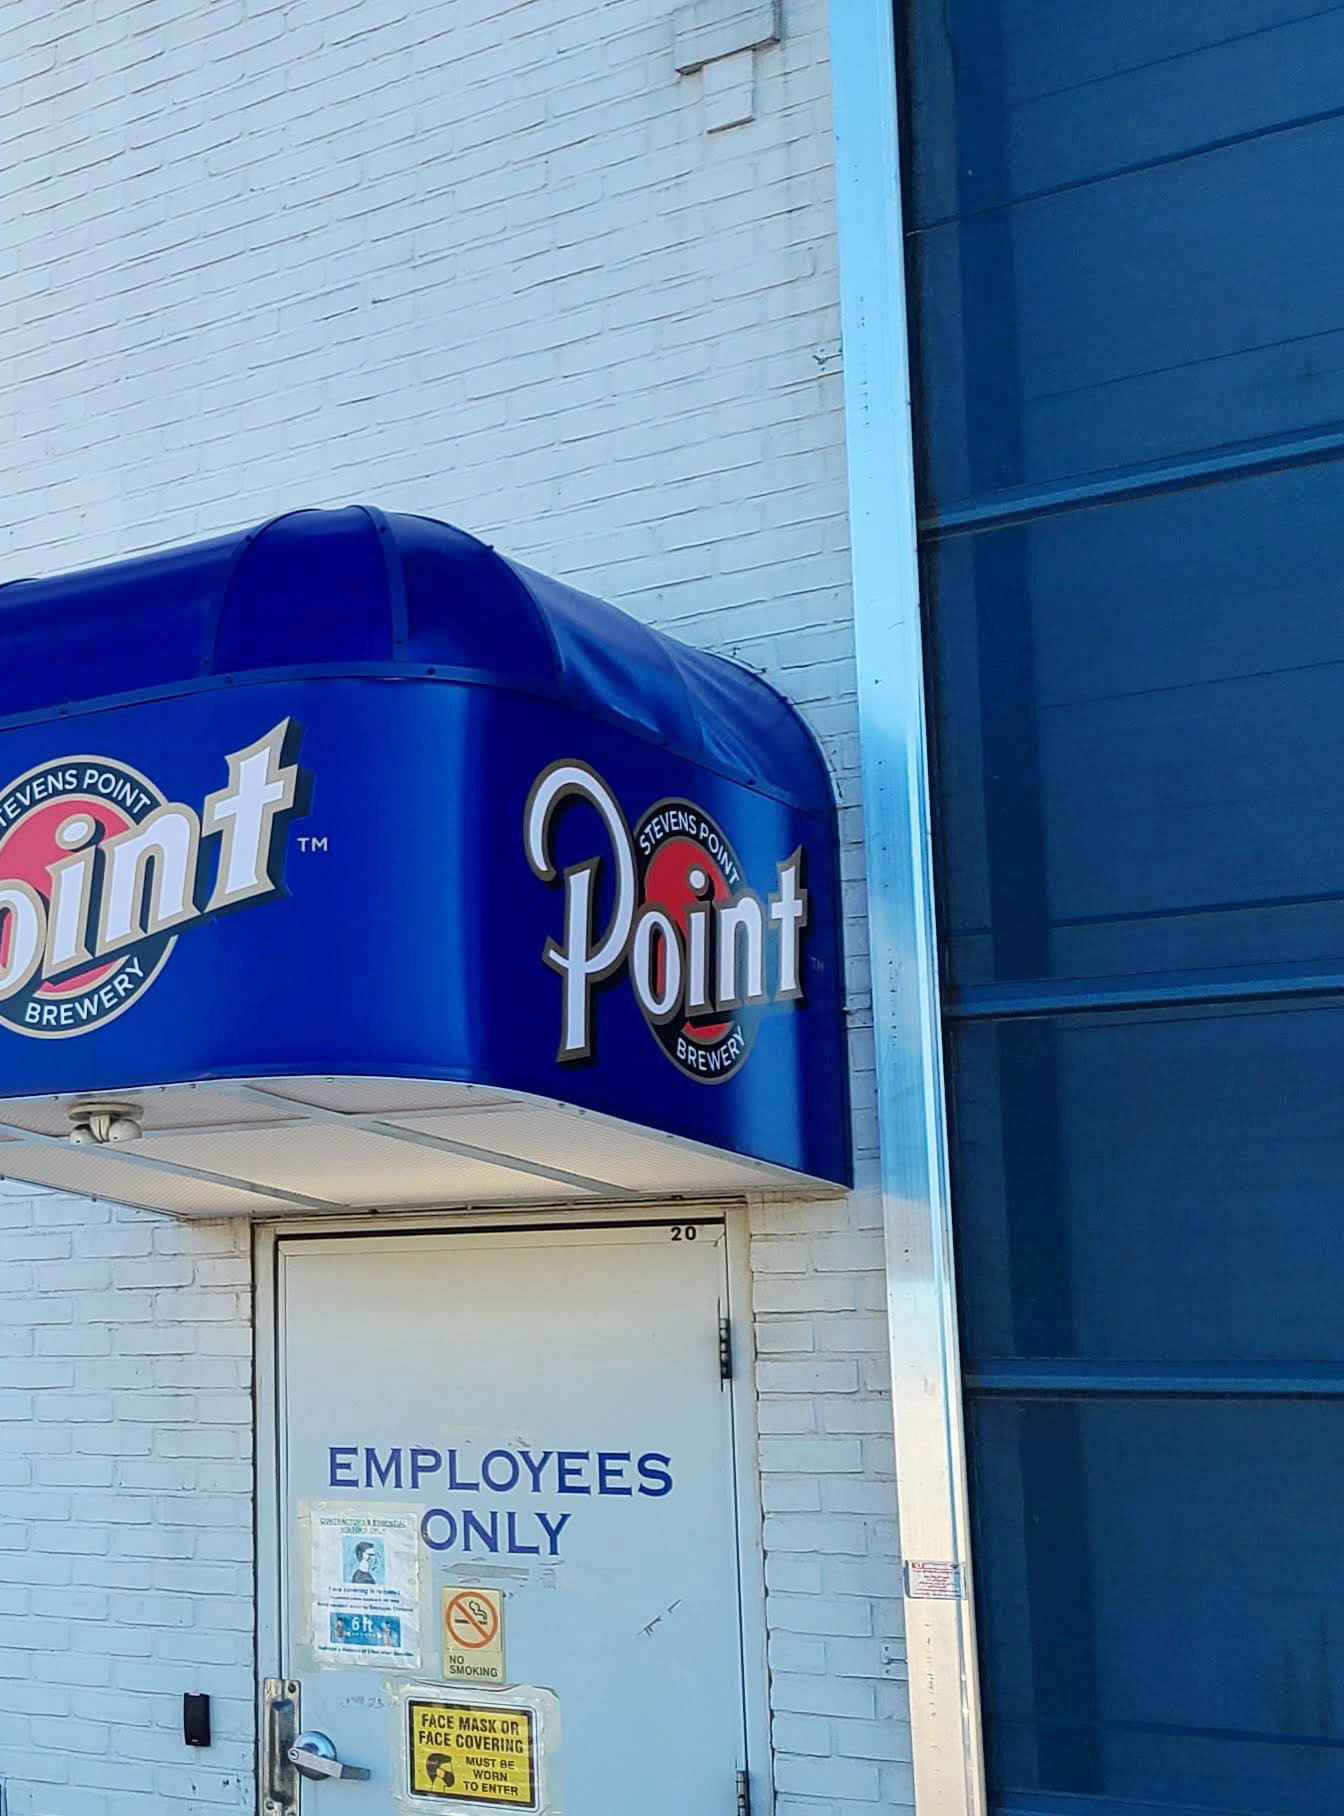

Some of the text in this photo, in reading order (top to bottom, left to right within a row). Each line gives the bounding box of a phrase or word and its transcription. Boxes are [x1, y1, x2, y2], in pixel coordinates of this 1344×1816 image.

[82, 772, 152, 825] POINT
[298, 837, 328, 852] TM
[639, 810, 741, 886] STEVENS POINT
[523, 758, 808, 1062] Point
[24, 956, 146, 1026] BREWERY
[676, 1025, 746, 1072] BREWERY
[671, 1226, 697, 1241] 20
[327, 1446, 674, 1498] EMPLOYEES
[420, 1507, 572, 1556] ONLY
[351, 1618, 375, 1633] 6 ft
[449, 1655, 464, 1664] NO
[449, 1665, 498, 1677] SMOKING
[421, 1713, 520, 1736] FACE MASK OR
[418, 1731, 524, 1754] FACE COVERING
[465, 1756, 515, 1770] MUST BE
[472, 1769, 508, 1781] WORN
[463, 1781, 519, 1796] TO ENTER
